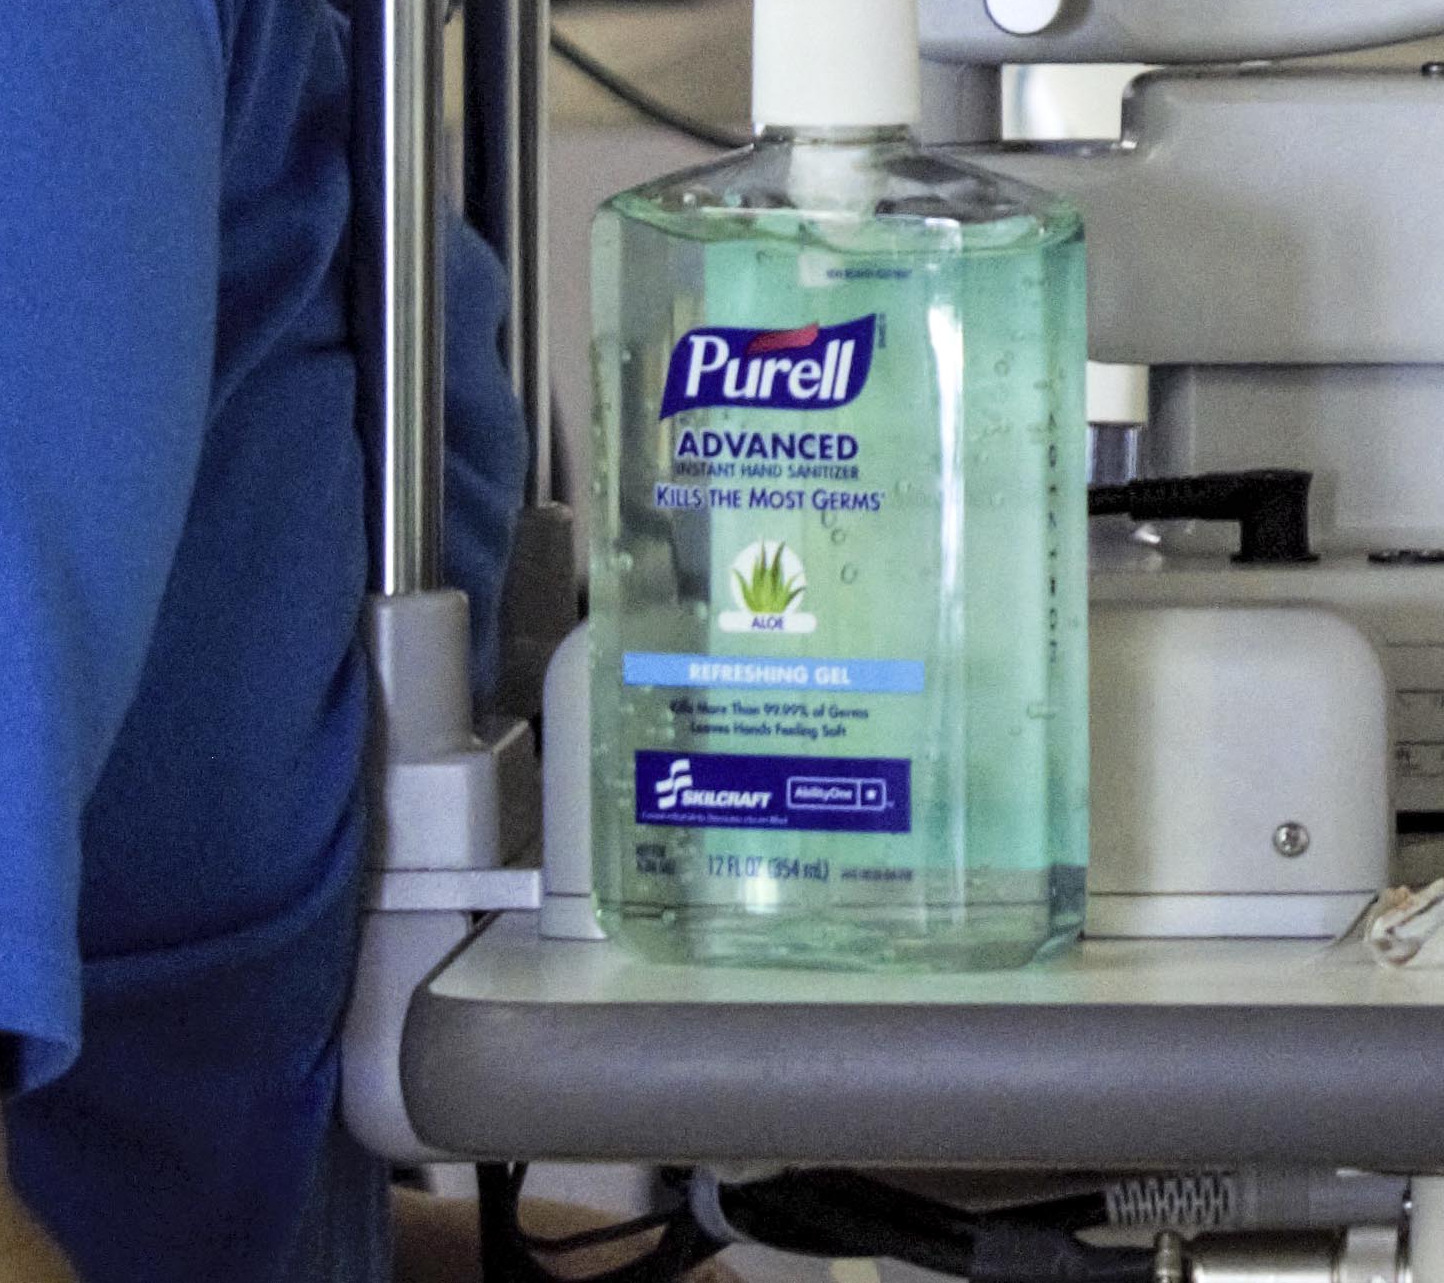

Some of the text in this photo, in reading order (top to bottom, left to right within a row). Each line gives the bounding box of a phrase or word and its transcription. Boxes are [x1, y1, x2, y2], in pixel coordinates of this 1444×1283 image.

[684, 334, 855, 400] Purell
[678, 431, 859, 461] ADVANCED
[676, 463, 860, 480] INSTANT HAND SANITIZER
[751, 617, 784, 630] ALOE
[688, 663, 852, 685] REFRESHING GEL
[680, 789, 773, 809] SKILCRAFT
[707, 855, 724, 877] 12
[727, 855, 741, 877] FL
